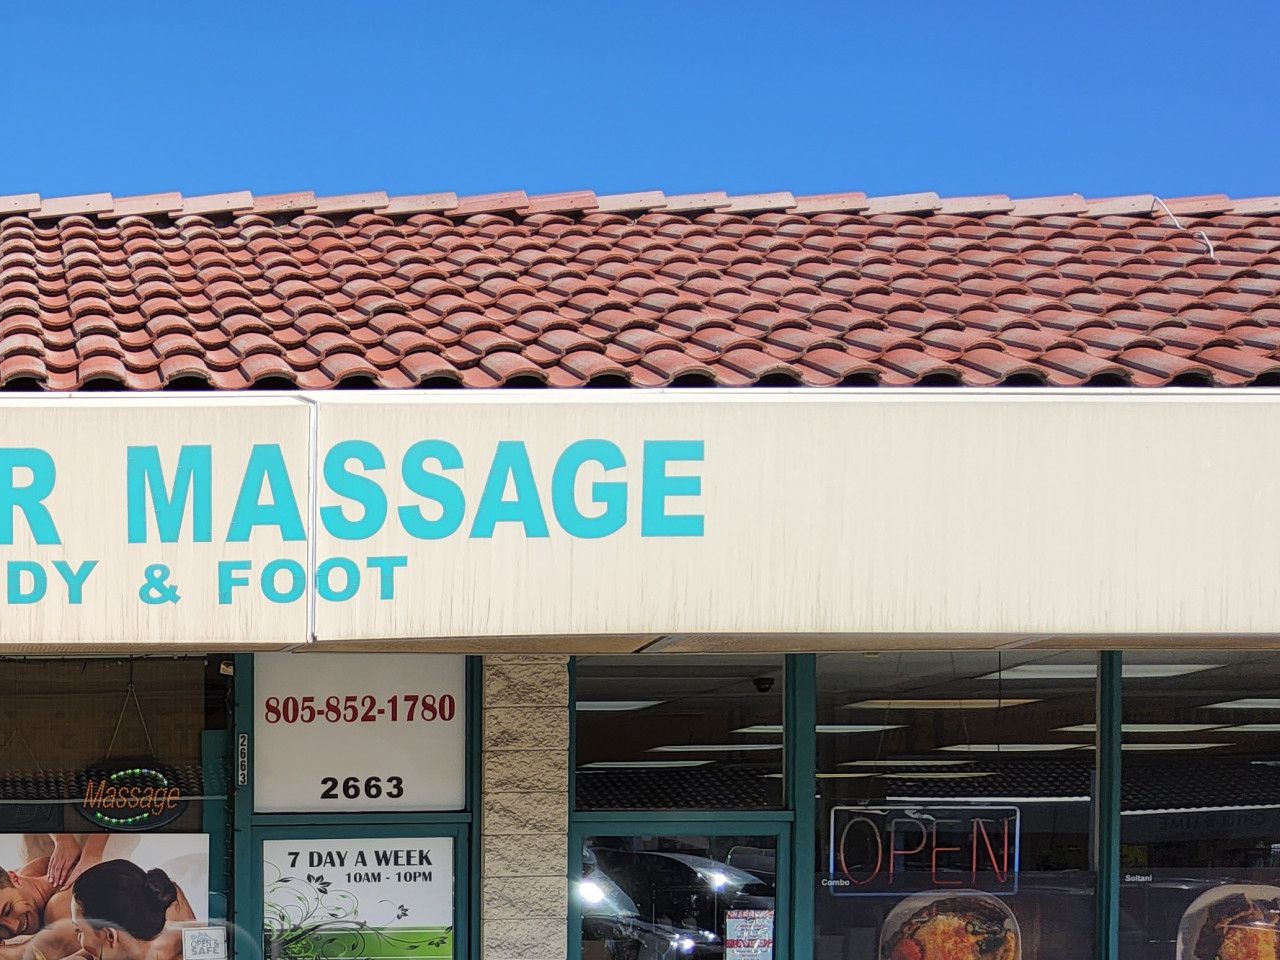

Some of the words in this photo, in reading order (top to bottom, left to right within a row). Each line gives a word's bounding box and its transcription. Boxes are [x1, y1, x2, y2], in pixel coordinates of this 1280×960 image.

[126, 440, 705, 544] MASSAGE
[139, 565, 180, 605] &
[218, 556, 409, 605] FOOT
[264, 694, 456, 724] 805-852-1780
[240, 735, 248, 785] 2663
[82, 779, 182, 816] Massage
[320, 776, 404, 800] 2663
[287, 851, 300, 868] 7
[308, 851, 349, 868] DAY
[354, 850, 368, 867] A
[375, 849, 433, 867] WEEK
[838, 815, 1009, 885] OPEN
[345, 871, 382, 883] 10AM
[395, 871, 433, 883] 10PM
[821, 878, 851, 887] Combo
